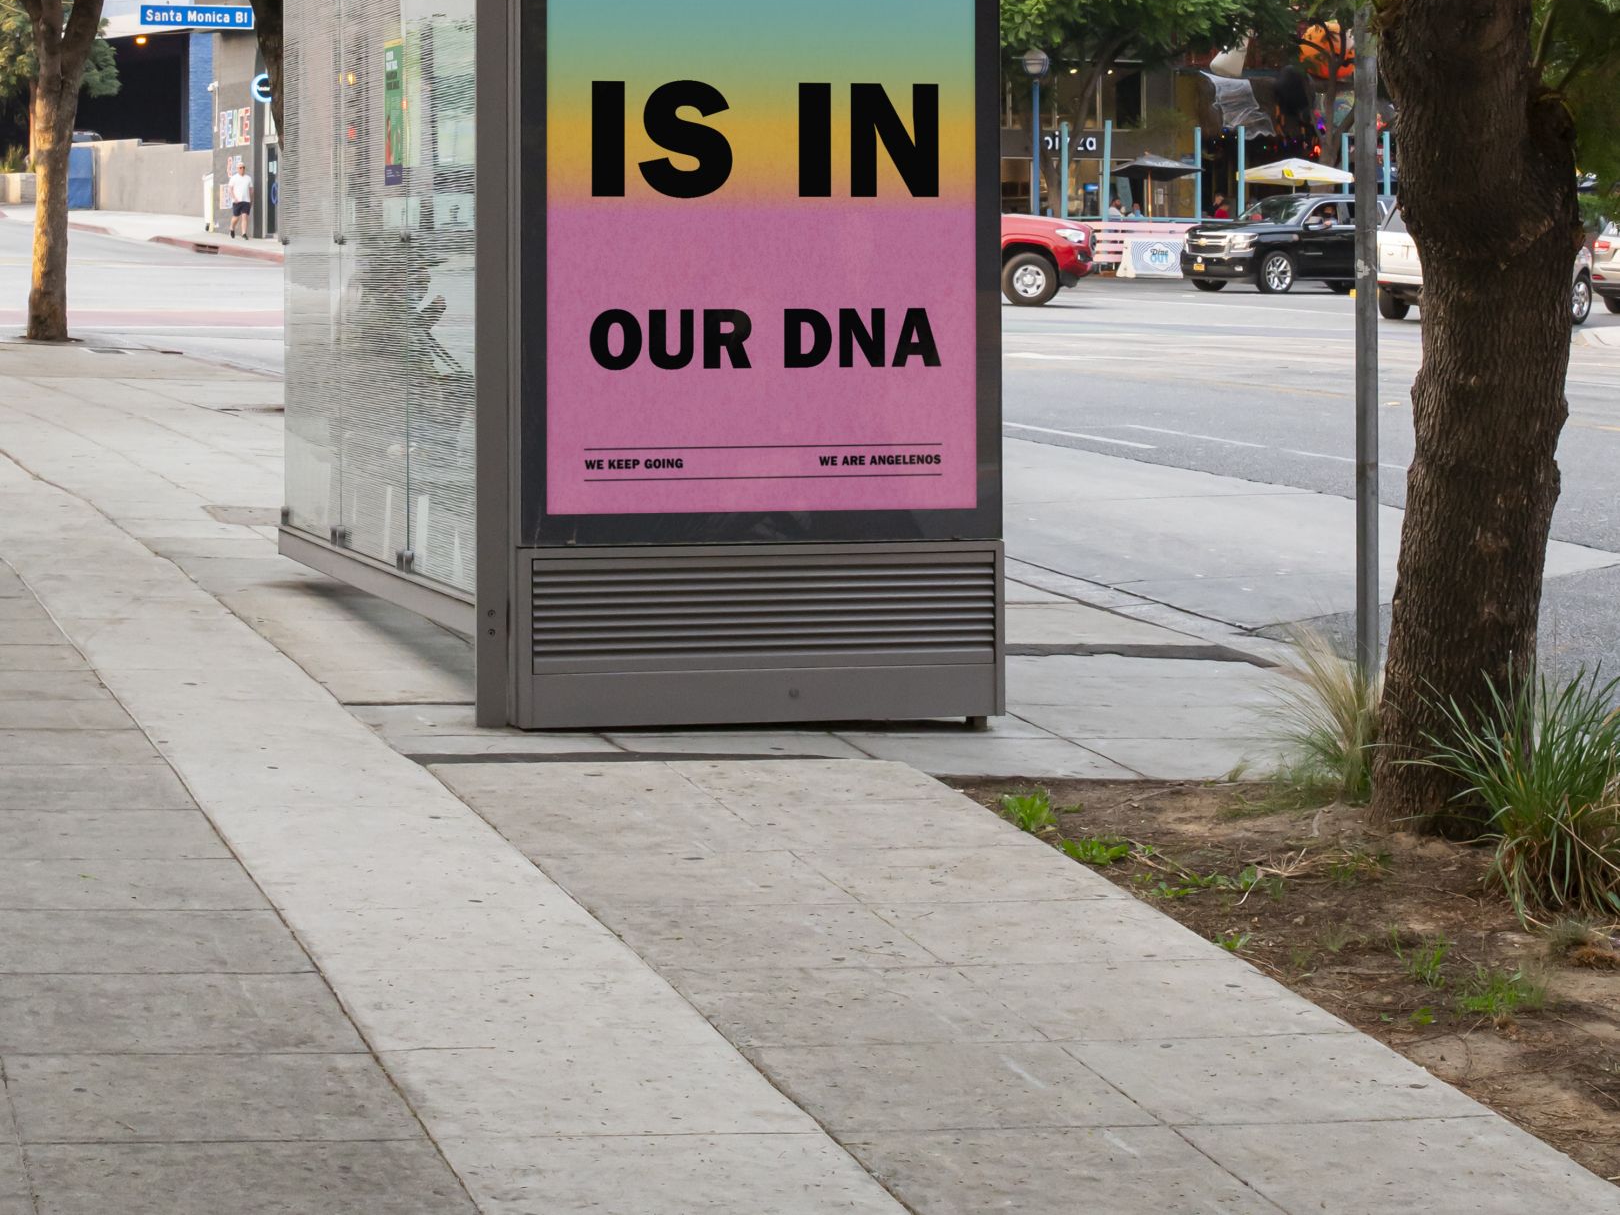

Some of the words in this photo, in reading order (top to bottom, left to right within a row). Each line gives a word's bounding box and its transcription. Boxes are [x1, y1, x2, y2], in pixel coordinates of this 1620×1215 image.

[145, 8, 182, 22] Santa
[187, 10, 230, 23] Monica
[219, 106, 251, 149] PEACE
[591, 79, 733, 199] IS
[798, 82, 940, 198] IN
[589, 308, 752, 371] OUR
[783, 307, 942, 369] DNA
[584, 459, 605, 470] WE
[608, 458, 640, 470] KEEP
[644, 458, 684, 469] GOING
[819, 455, 838, 466] WE
[842, 455, 865, 466] ARE
[870, 454, 942, 465] ANGELENOS
